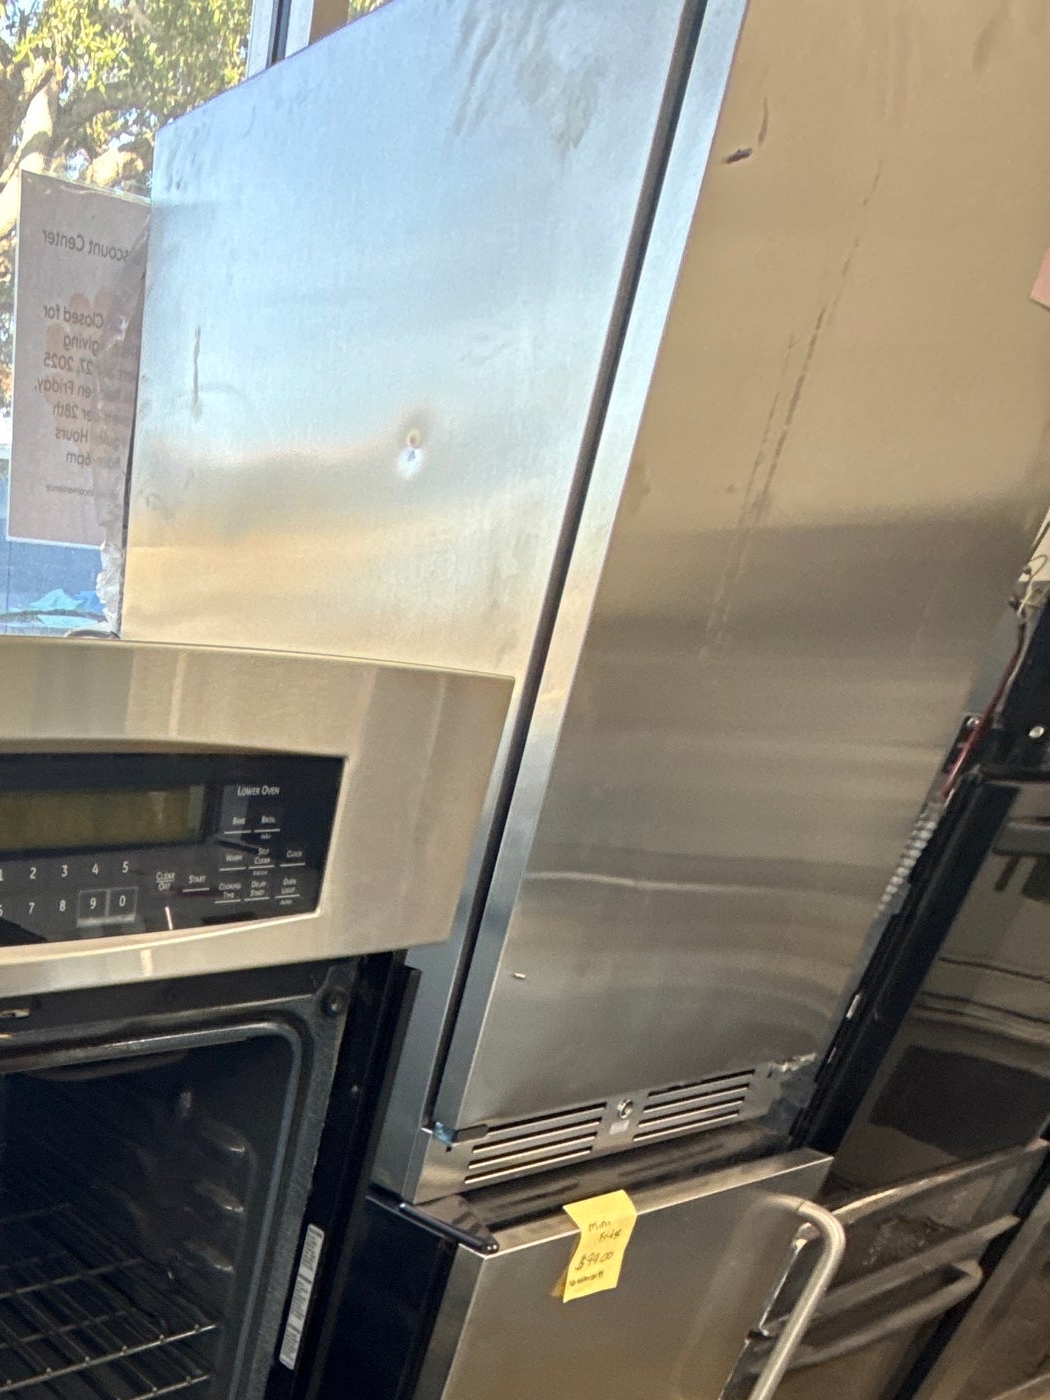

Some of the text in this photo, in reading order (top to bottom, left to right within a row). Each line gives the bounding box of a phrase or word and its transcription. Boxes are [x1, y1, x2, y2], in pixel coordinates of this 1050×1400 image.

[237, 785, 280, 797] LOWER OVEN
[30, 867, 37, 880] 2
[61, 864, 68, 877] 3
[92, 863, 99, 875] 4
[122, 861, 129, 874] 5
[155, 871, 176, 881] CLEAR
[188, 874, 206, 884] START
[158, 882, 171, 891] OFF
[28, 902, 35, 914] 7
[59, 899, 66, 912] 8
[89, 897, 97, 910] 9
[119, 895, 126, 907] 0
